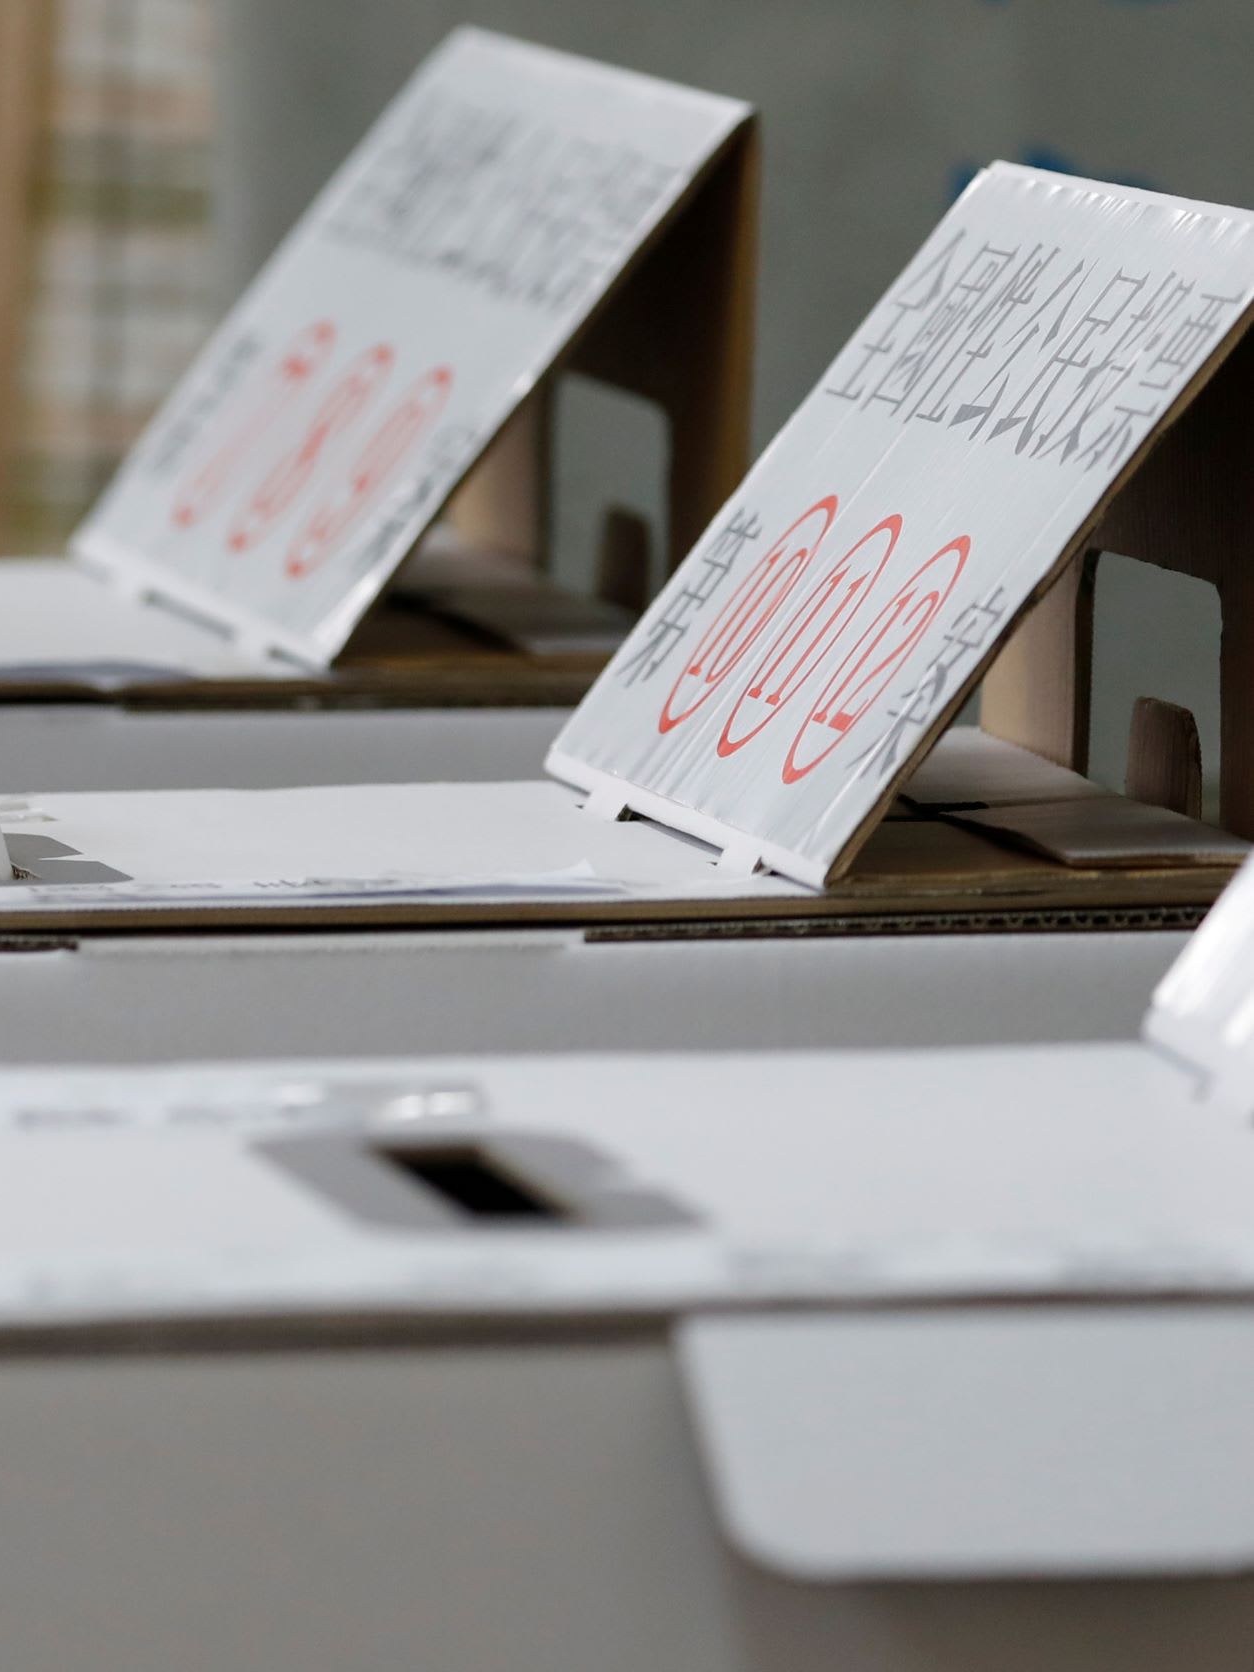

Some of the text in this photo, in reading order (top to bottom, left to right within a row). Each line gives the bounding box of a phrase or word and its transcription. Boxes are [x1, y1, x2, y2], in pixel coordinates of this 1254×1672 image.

[825, 228, 1243, 471] 全國性公民投票
[619, 508, 762, 686] 第
[846, 586, 1005, 778] 案
